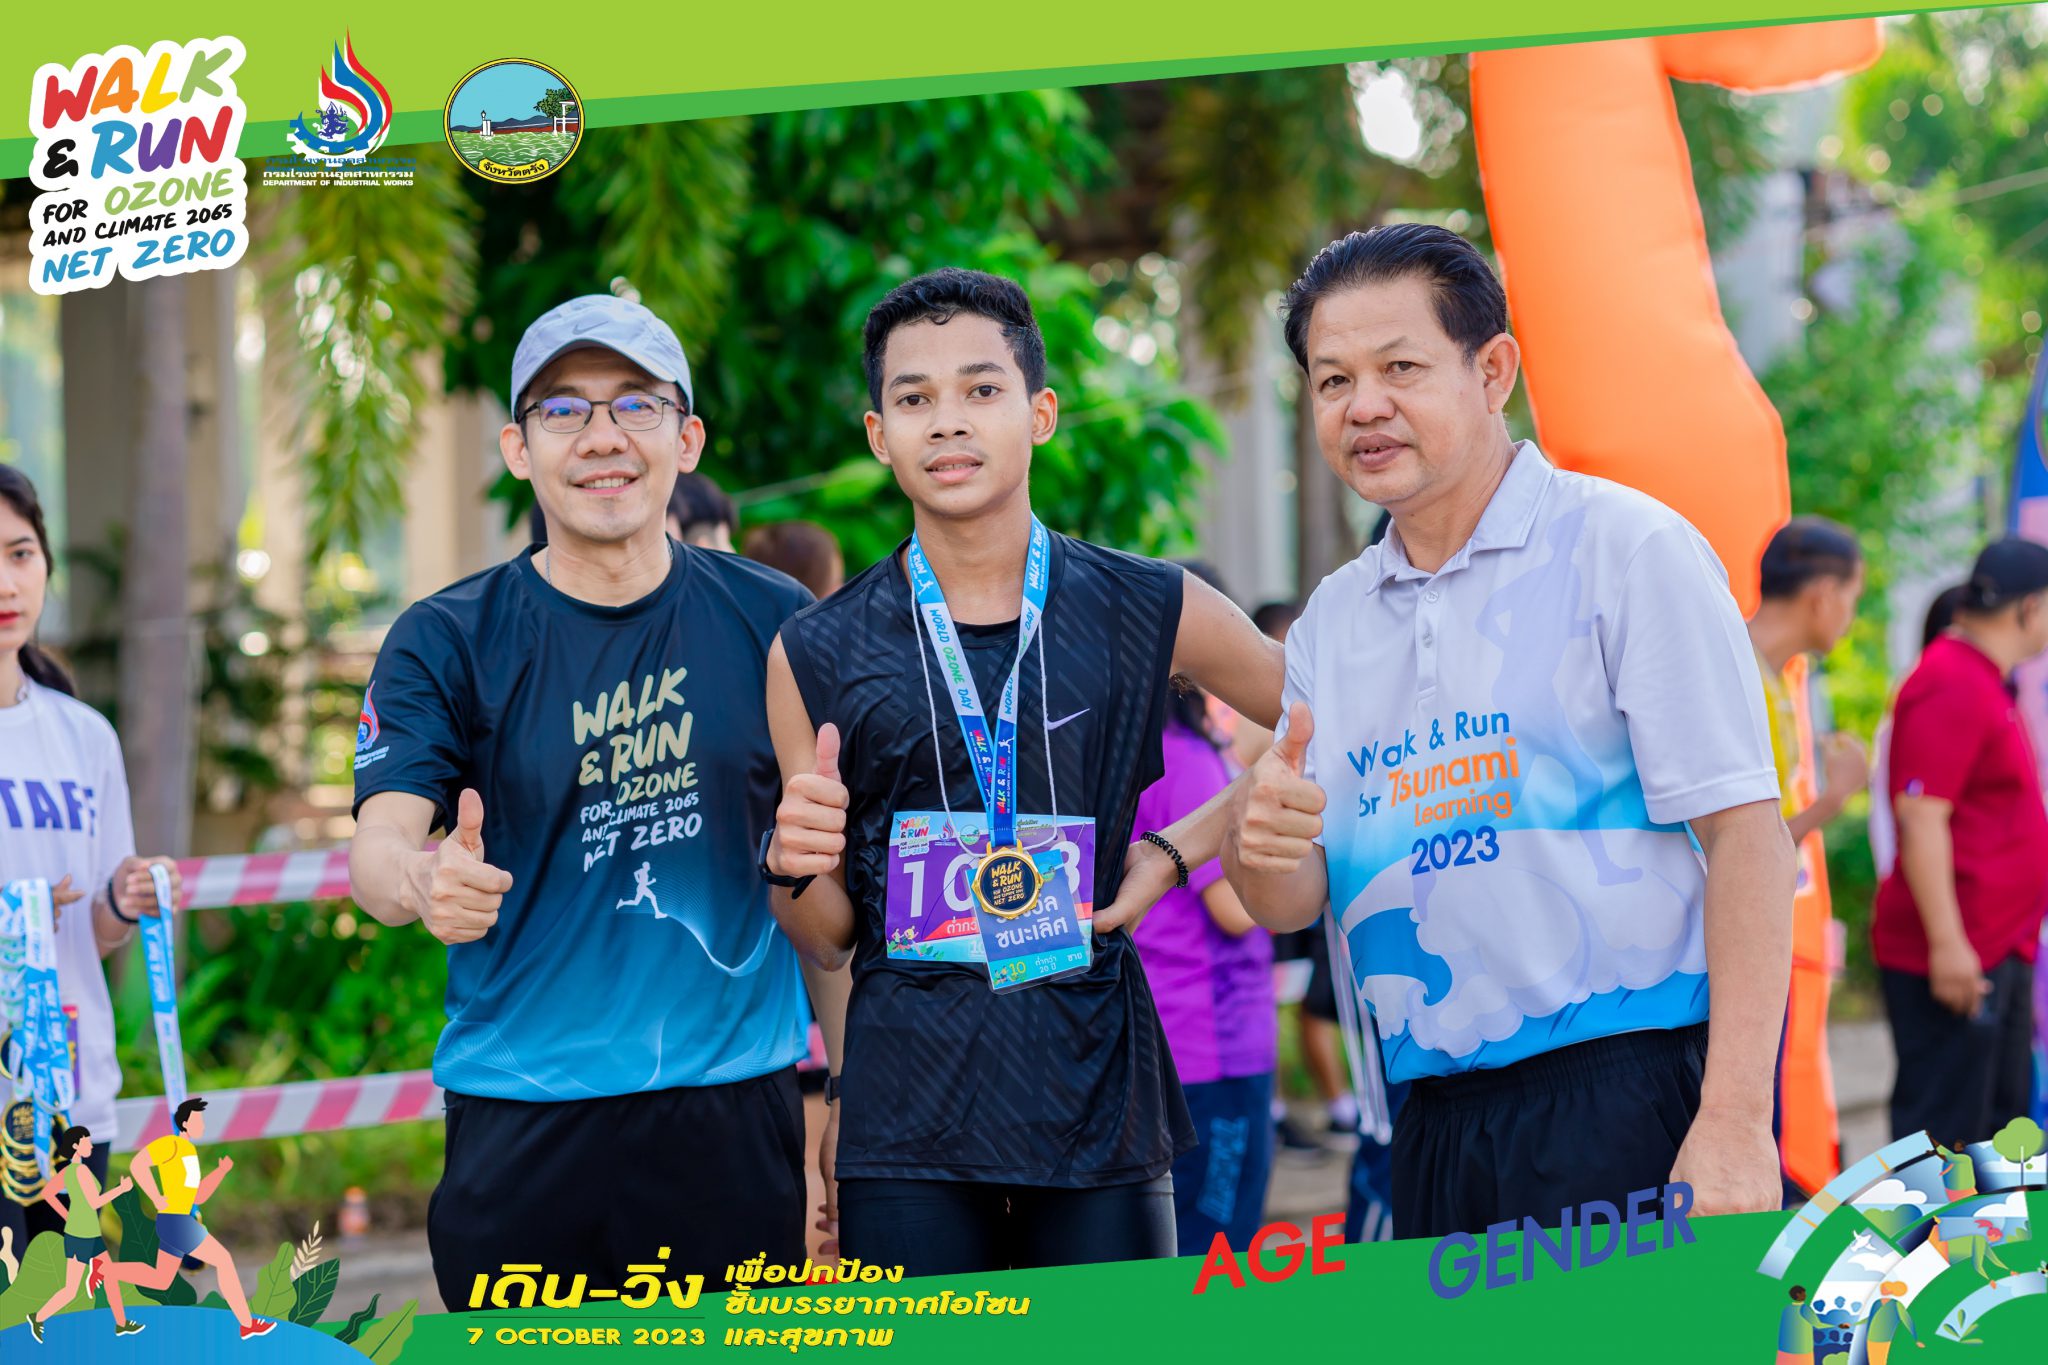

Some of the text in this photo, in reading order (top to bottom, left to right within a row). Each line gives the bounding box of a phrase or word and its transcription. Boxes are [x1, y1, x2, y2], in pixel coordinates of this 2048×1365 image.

[1029, 563, 1041, 590] WALK
[1024, 607, 1035, 631] DAY
[929, 609, 974, 710] WORLD OZONE DAY
[573, 667, 687, 745] WALK
[579, 711, 693, 786] & RUN
[1347, 711, 1510, 778] Wak & Run
[1388, 736, 1520, 808] Tsunami
[580, 800, 613, 824] FOR
[608, 802, 660, 826] CLIMATE
[665, 792, 699, 814] 2065
[630, 812, 702, 851] ZERO
[908, 826, 929, 838] RUN
[1411, 825, 1500, 876] 2023
[991, 861, 1021, 879] WALK
[992, 871, 1022, 888] & RUN
[995, 916, 1069, 948] ชนะเลิศ
[1008, 961, 1026, 977] 10
